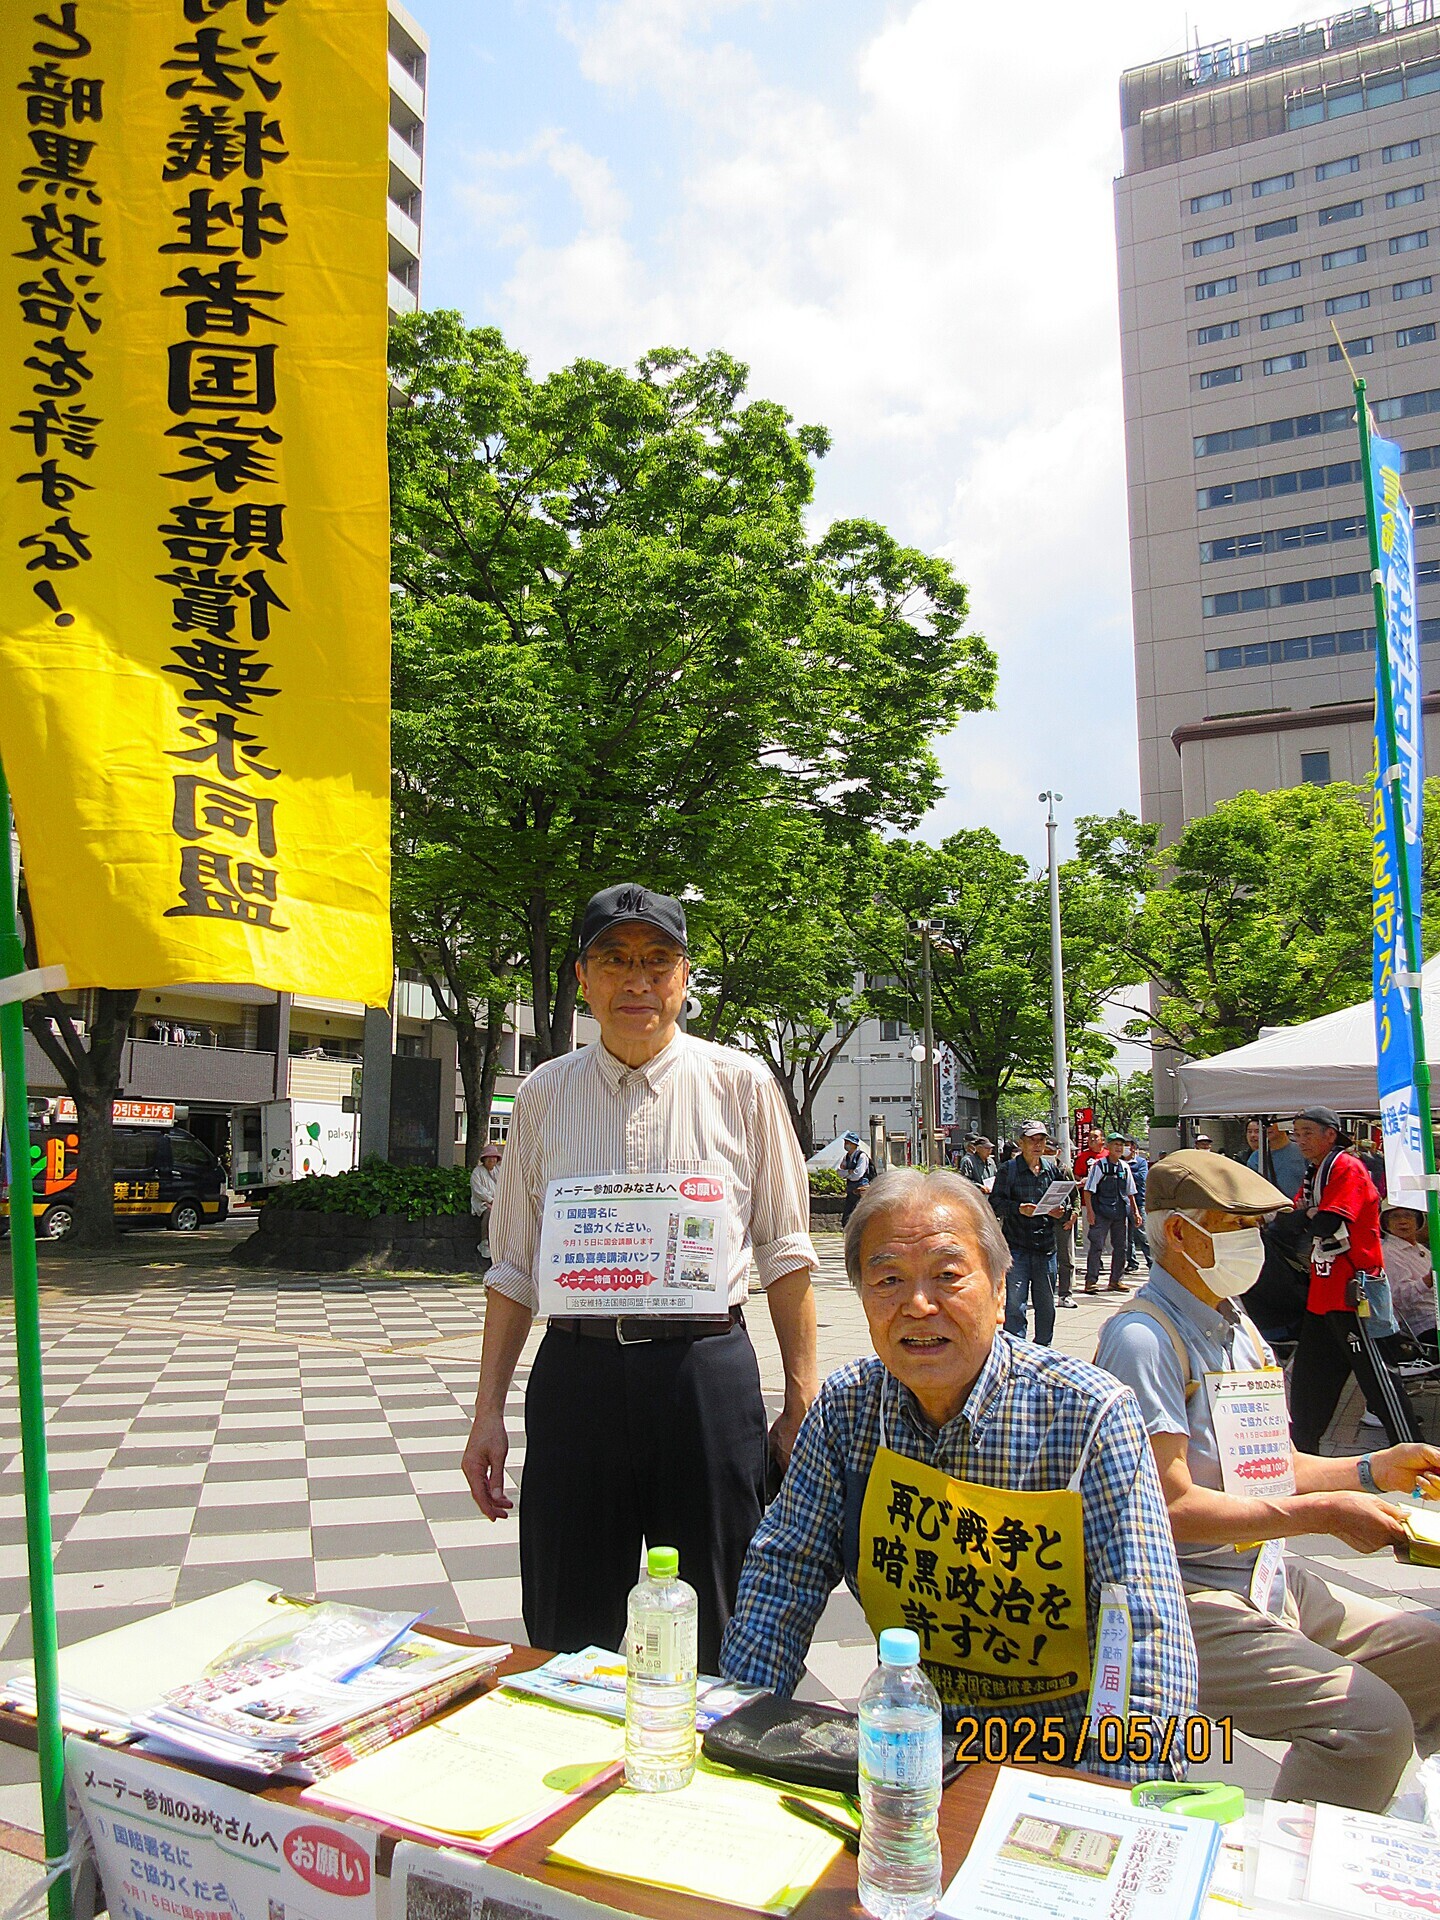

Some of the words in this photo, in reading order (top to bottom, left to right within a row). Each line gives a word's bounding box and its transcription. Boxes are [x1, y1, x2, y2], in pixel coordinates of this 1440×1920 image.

[555, 1182, 677, 1197] メーデー参加のみなさんへ
[683, 1182, 723, 1197] お願い
[567, 1207, 617, 1219] 国賠署名に
[573, 1221, 652, 1234] ご協力ください。
[571, 1297, 686, 1308] 治安維持法国賠同盟千葉県本部
[887, 1479, 1063, 1571] 再び戦争と
[871, 1534, 1072, 1631] 暗黒政治を
[1108, 1610, 1124, 1625] 署名
[900, 1598, 1049, 1666] 許すな!
[1102, 1628, 1127, 1641] チラシ
[1102, 1646, 1122, 1660] 配布
[84, 1770, 279, 1853] メーデー参加のみなさんへ
[113, 1822, 193, 1869] 国賠署名に
[292, 1834, 365, 1884] お願い
